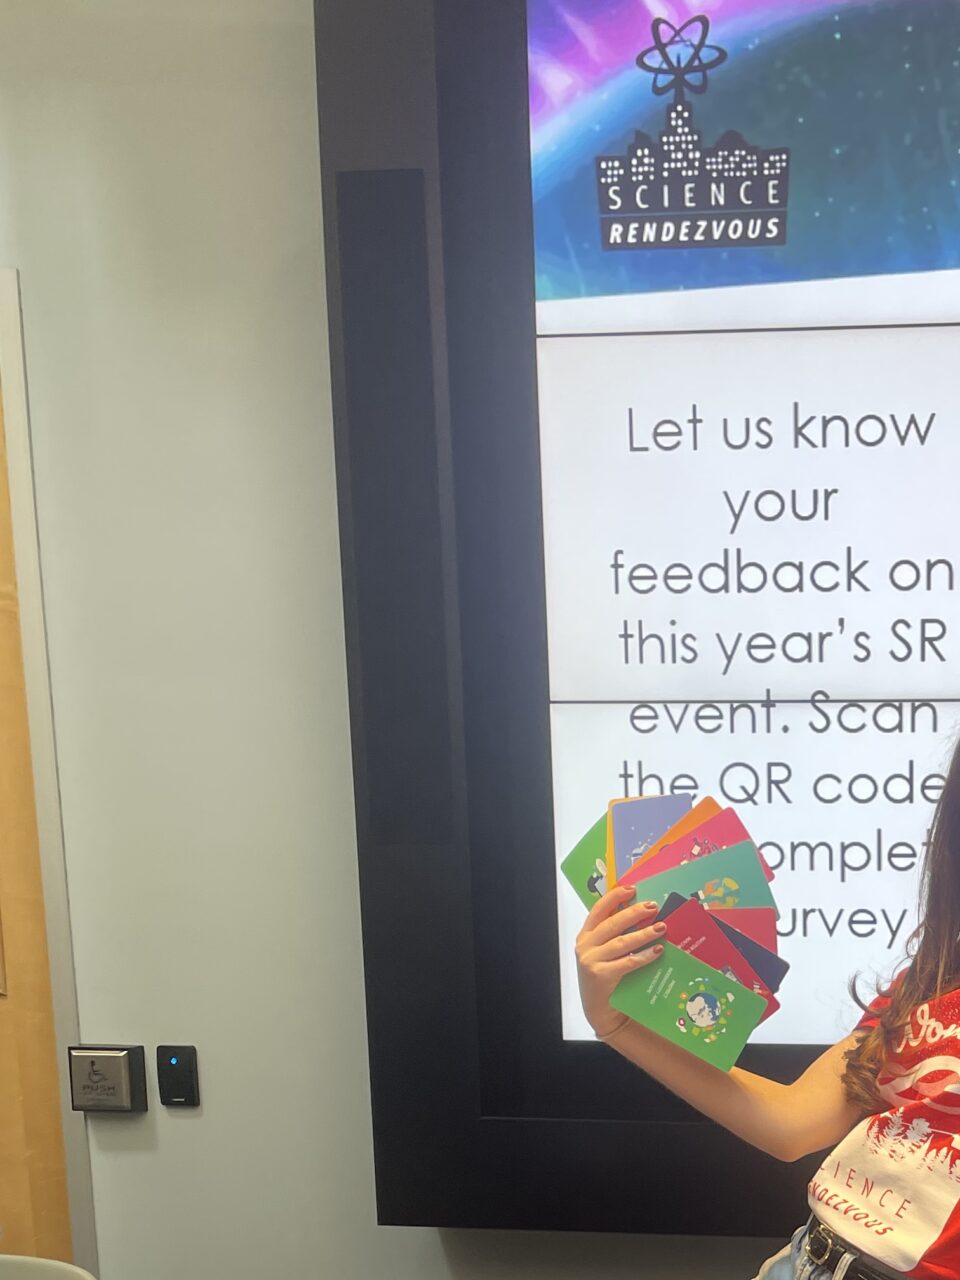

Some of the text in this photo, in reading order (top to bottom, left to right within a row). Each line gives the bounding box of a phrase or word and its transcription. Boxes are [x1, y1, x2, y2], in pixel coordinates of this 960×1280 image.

[608, 180, 781, 211] SCIENCE
[609, 217, 781, 244] RENDEZVOUS
[627, 401, 936, 453] Let us know
[722, 487, 839, 535] your
[610, 546, 955, 595] feedback on
[618, 619, 699, 665] this
[889, 618, 948, 663] SR
[629, 688, 938, 734] event. Scan
[619, 760, 946, 806] the QR code
[759, 829, 935, 883] omplet
[777, 908, 907, 949] urvey
